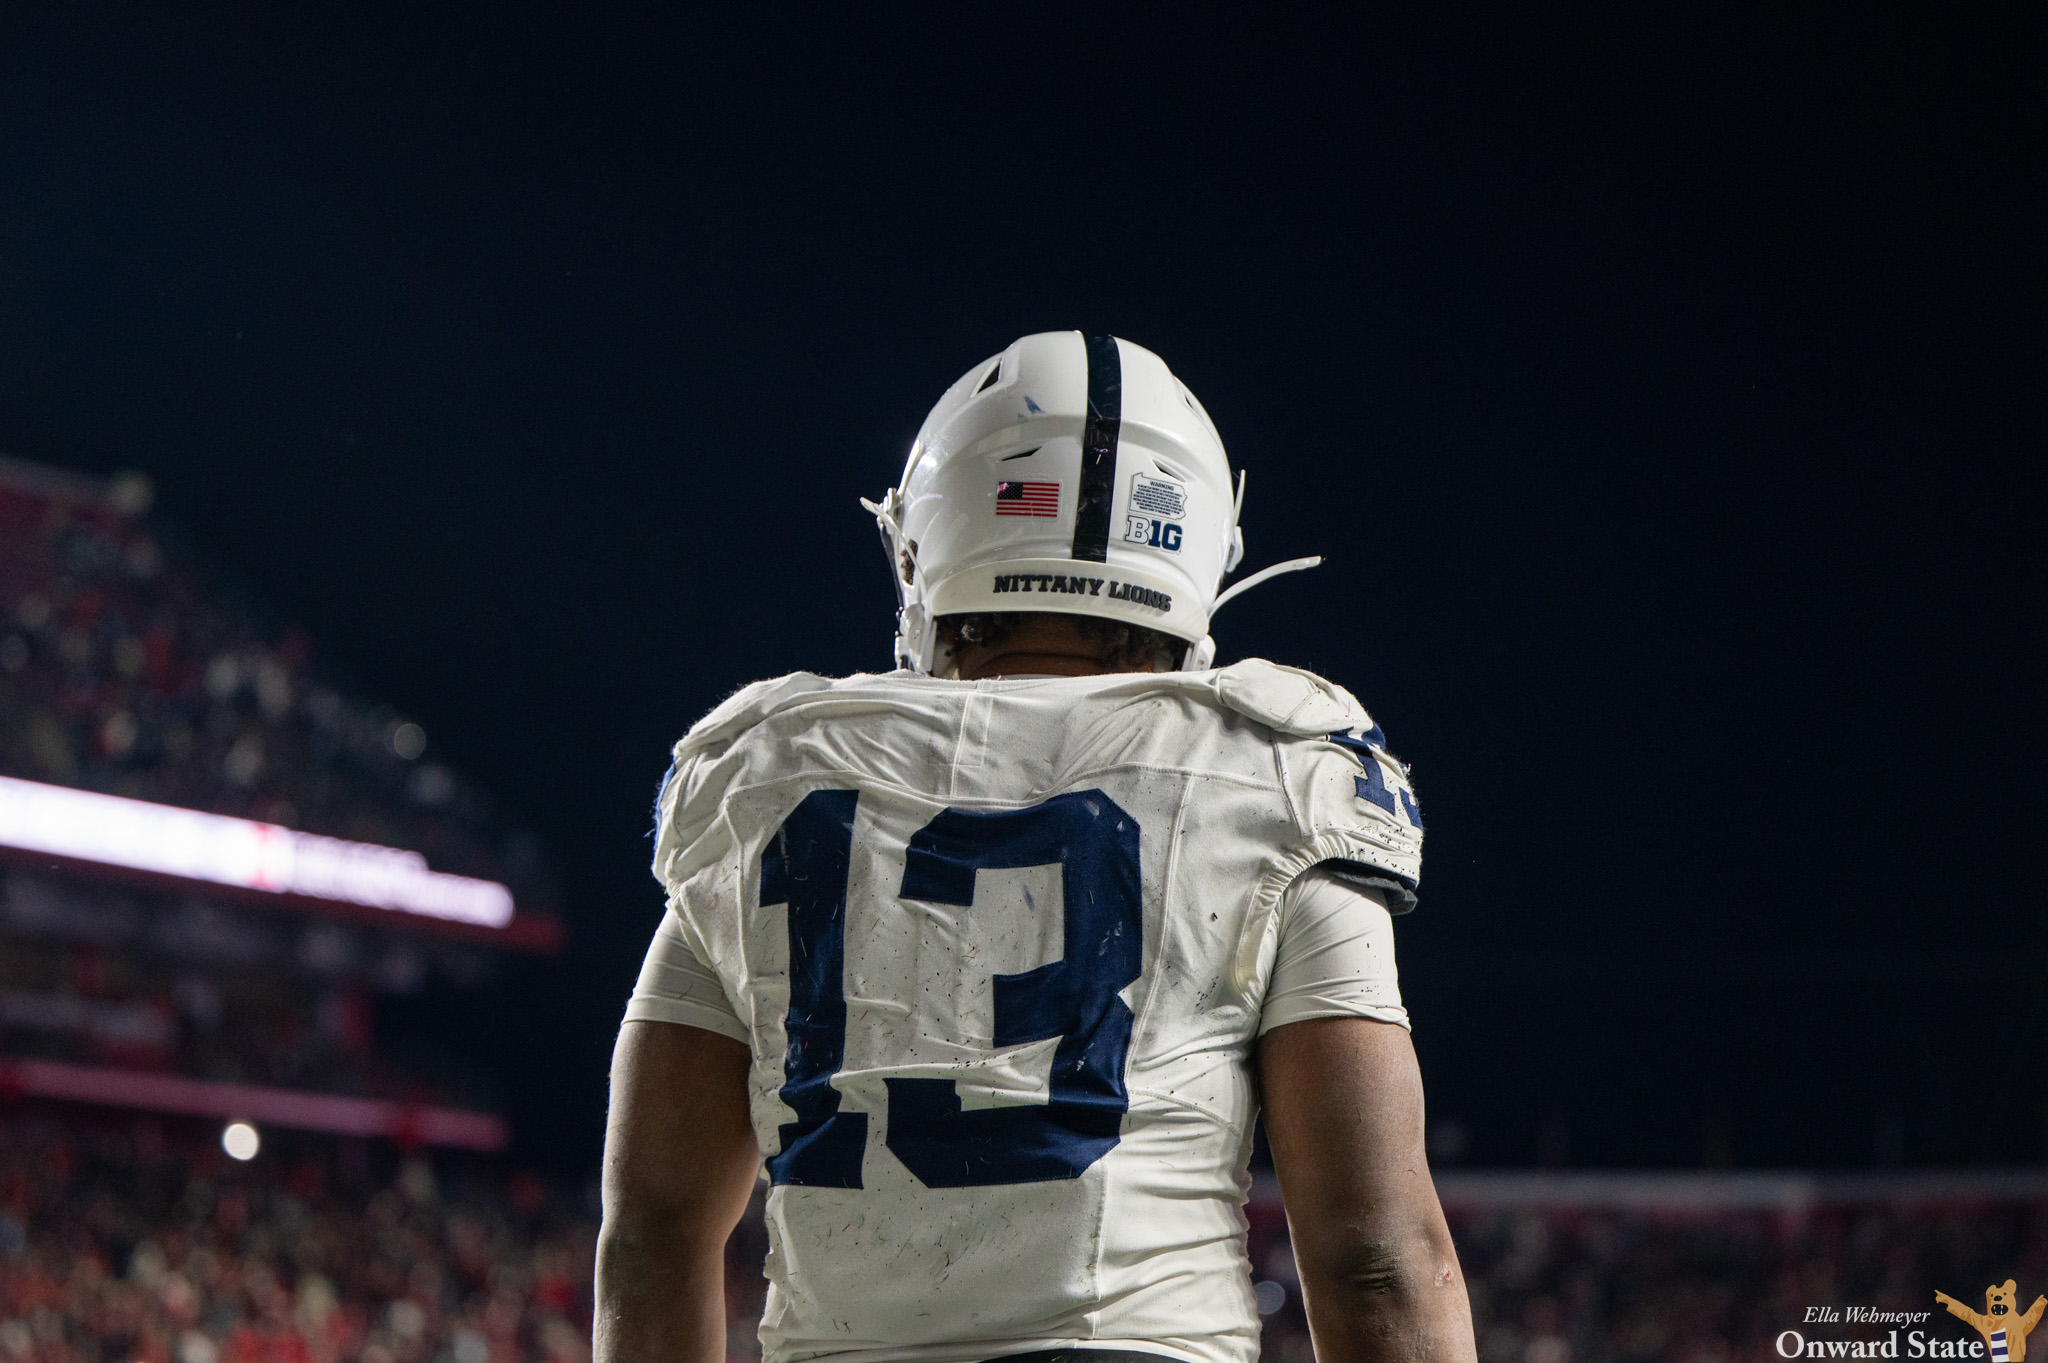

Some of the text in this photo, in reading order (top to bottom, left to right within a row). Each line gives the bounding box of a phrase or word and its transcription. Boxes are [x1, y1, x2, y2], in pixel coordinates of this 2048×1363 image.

[1150, 481, 1174, 491] WARNING
[993, 574, 1172, 612] NITTANY LIONS
[759, 788, 1143, 1190] 13
